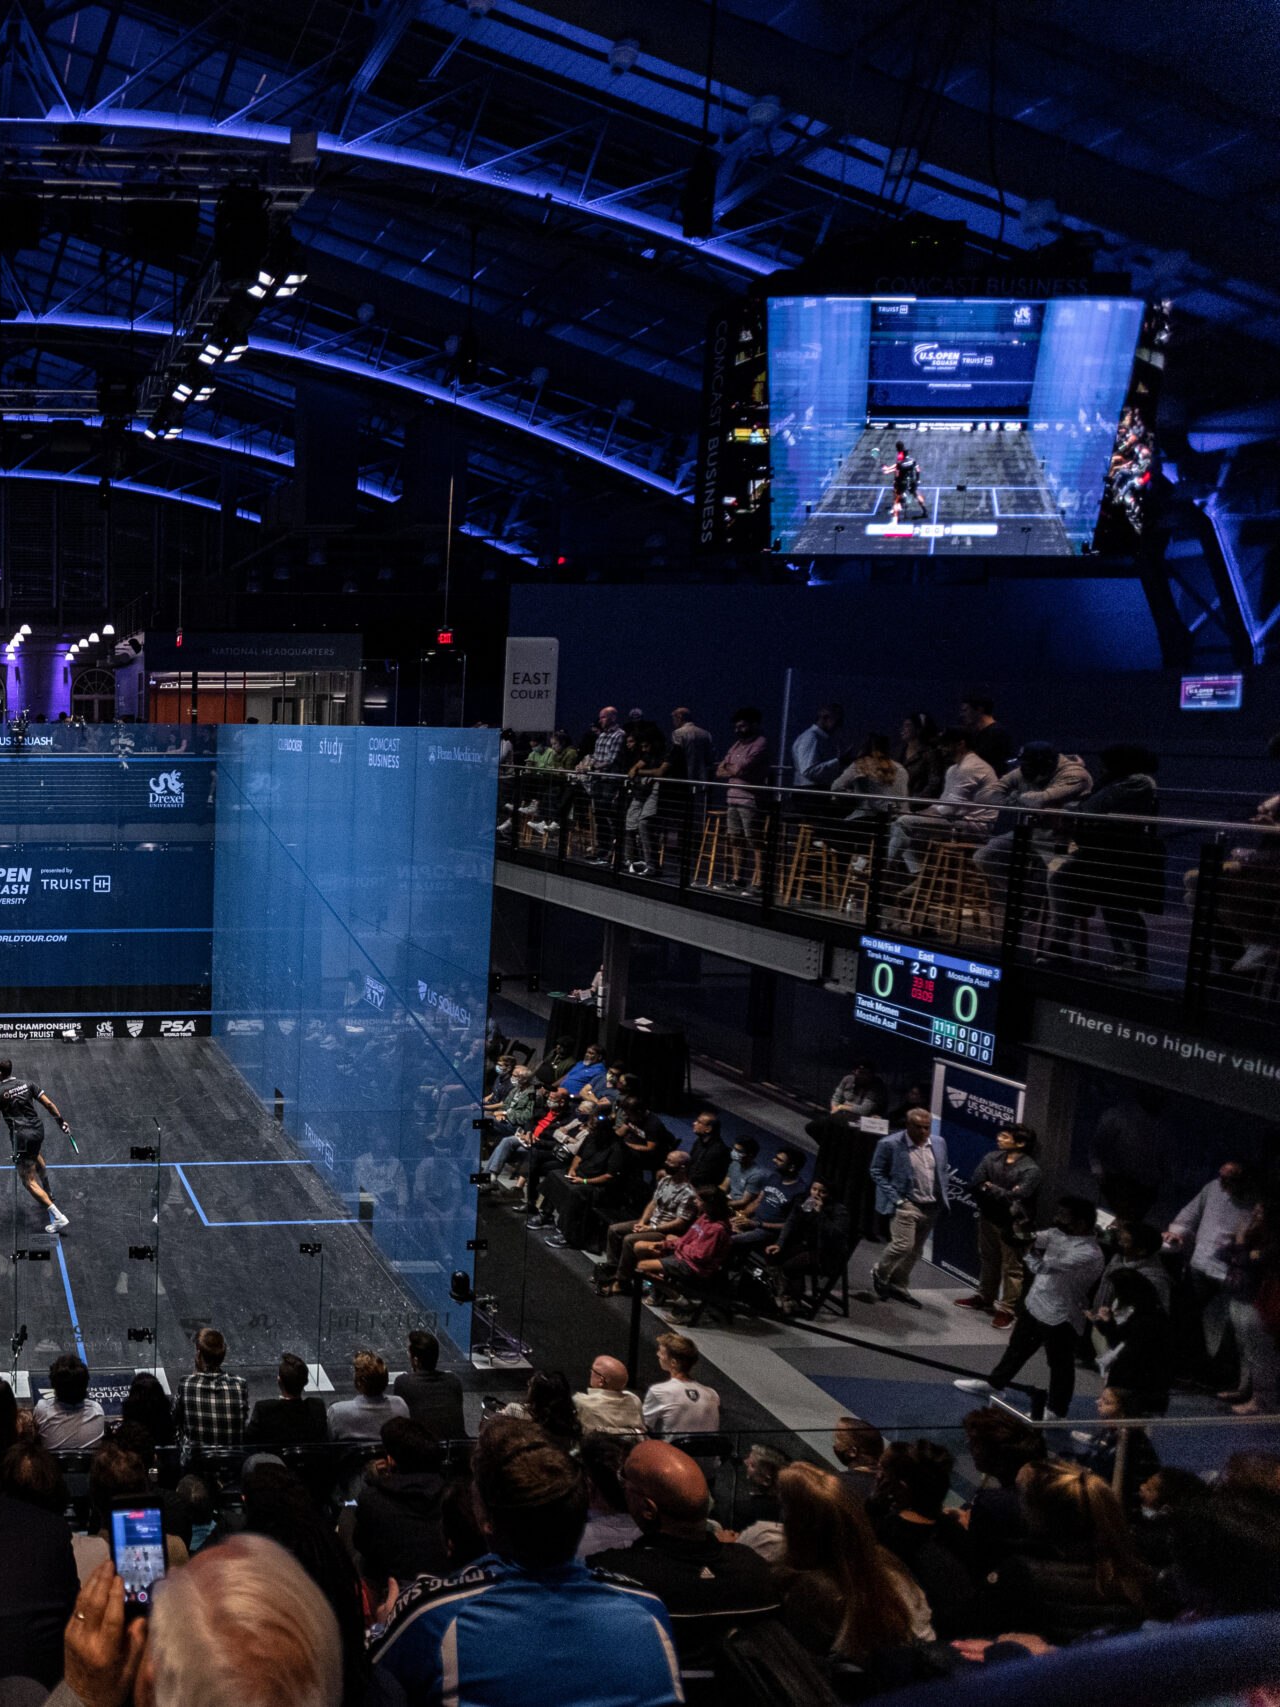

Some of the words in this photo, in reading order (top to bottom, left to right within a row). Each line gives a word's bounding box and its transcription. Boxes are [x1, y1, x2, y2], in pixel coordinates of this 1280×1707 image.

[874, 276, 980, 294] COMCAST
[986, 277, 1089, 296] BUSINESS
[708, 320, 729, 427] COMCAST
[701, 436, 720, 544] BUSINESS
[212, 648, 258, 656] NATIONAL
[261, 648, 335, 656] HEADQUARTERS
[512, 672, 551, 686] EAST
[510, 689, 551, 700] COURT
[319, 736, 343, 763] study
[369, 737, 401, 751] COMCAST
[368, 753, 400, 769] BUSINESS
[149, 792, 185, 804] Drexel
[41, 879, 91, 890] TRUIST
[918, 950, 935, 963] East
[874, 962, 894, 998] 0
[969, 963, 992, 978] Game
[993, 969, 1000, 979] 3
[427, 989, 438, 1006] US
[439, 994, 471, 1026] SQUASH
[954, 984, 978, 1023] 0
[160, 1021, 196, 1032] PSA
[856, 997, 875, 1010] Tarek
[875, 1001, 899, 1017] Momen
[934, 1020, 945, 1032] 11
[945, 1024, 956, 1036] 11
[959, 1028, 966, 1039] 0
[971, 1031, 978, 1042] 0
[983, 1035, 990, 1046] 0
[18, 1031, 28, 1039] by
[856, 1009, 882, 1025] Mostafa
[882, 1017, 897, 1030] Asal
[934, 1034, 941, 1044] 5
[946, 1038, 953, 1049] 5
[958, 1042, 964, 1053] 0
[970, 1046, 977, 1057] 0
[982, 1050, 989, 1061] 0
[1117, 1023, 1131, 1039] is
[1135, 1031, 1158, 1046] no
[1163, 1035, 1226, 1064] higher
[967, 1100, 978, 1110] US
[979, 1104, 1014, 1123] SQUASH
